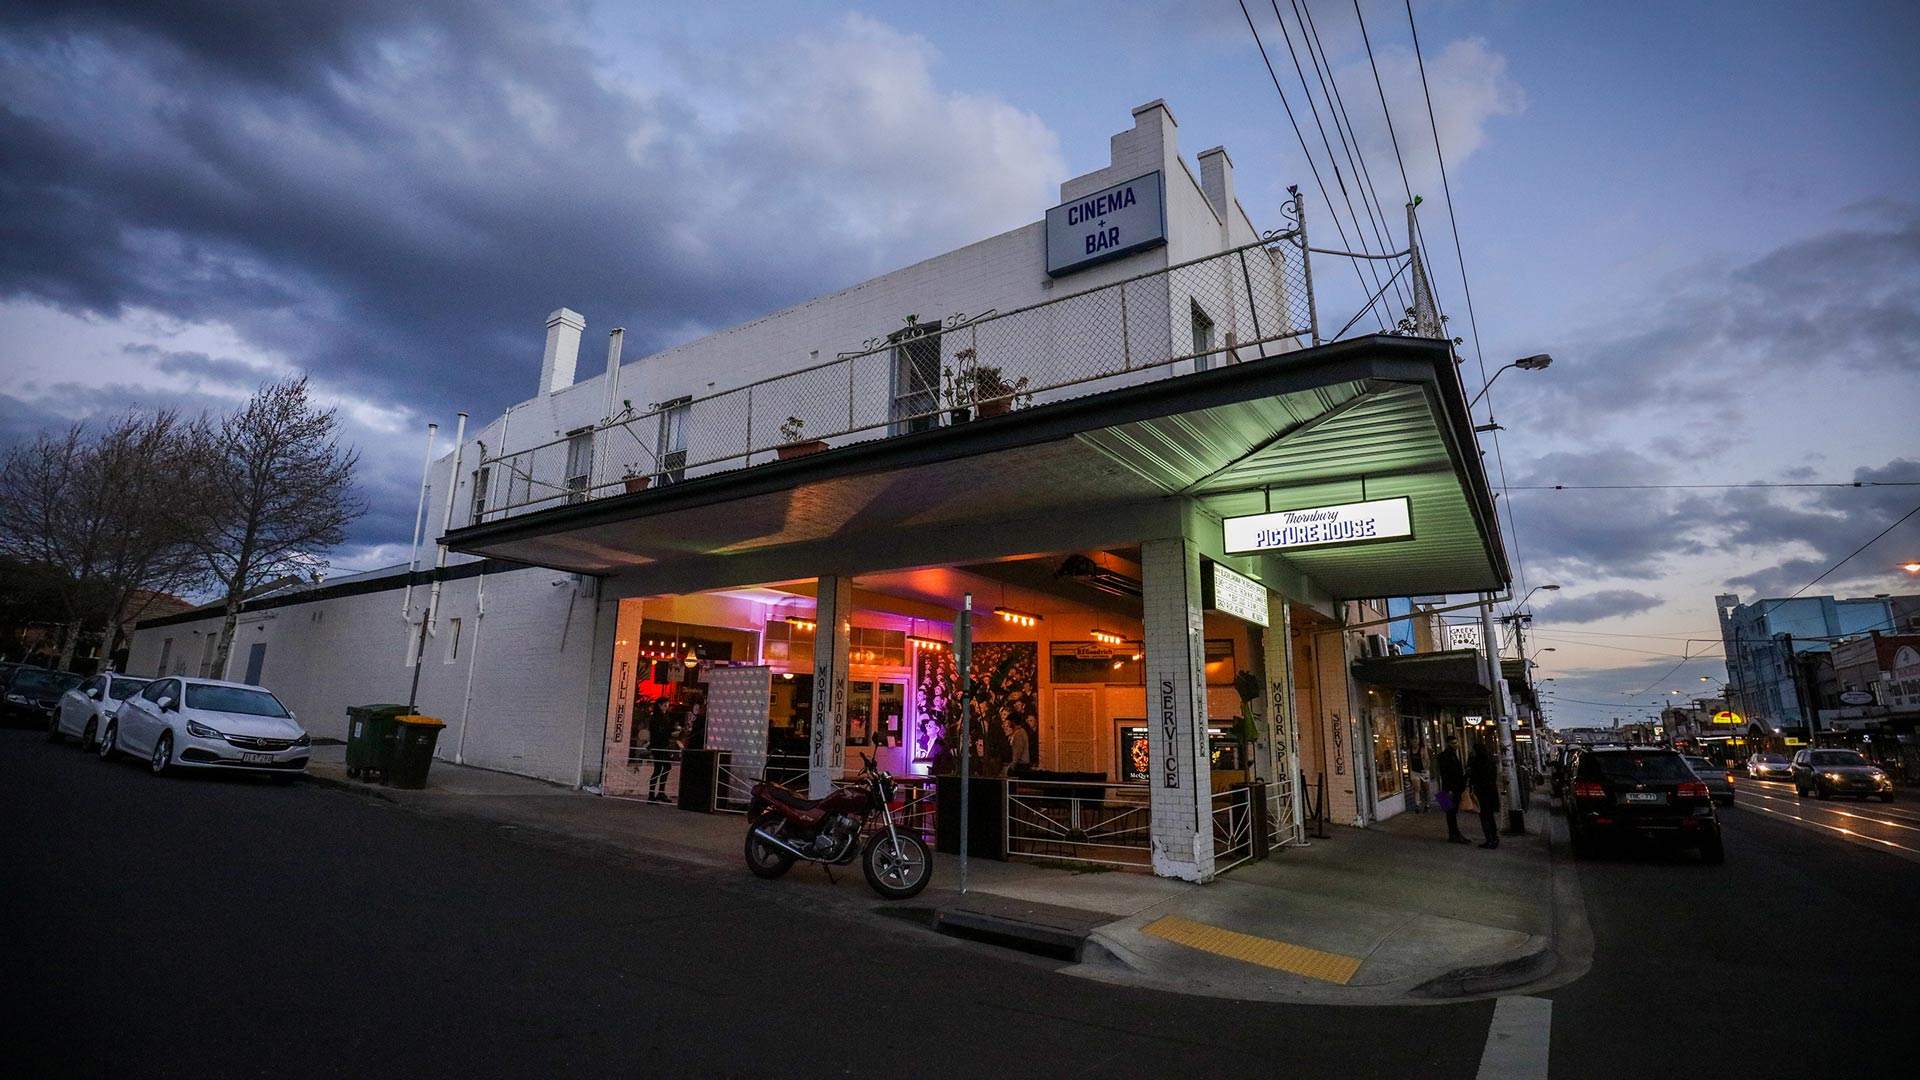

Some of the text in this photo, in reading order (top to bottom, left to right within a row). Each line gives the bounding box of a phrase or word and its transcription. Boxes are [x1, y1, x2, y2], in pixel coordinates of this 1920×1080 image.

[1068, 187, 1136, 226] CINEMA
[1086, 226, 1120, 255] BAR
[1256, 518, 1376, 547] PICTURE HOUSE
[1283, 510, 1339, 524] Thornbury
[1451, 632, 1477, 640] STREET
[615, 662, 629, 742] FILL HERE
[816, 667, 826, 724] MOTOR
[835, 679, 844, 736] MOTOR
[1273, 682, 1285, 735] MOTOR
[1162, 681, 1177, 787] SERVICE
[1333, 713, 1344, 775] SERVICE
